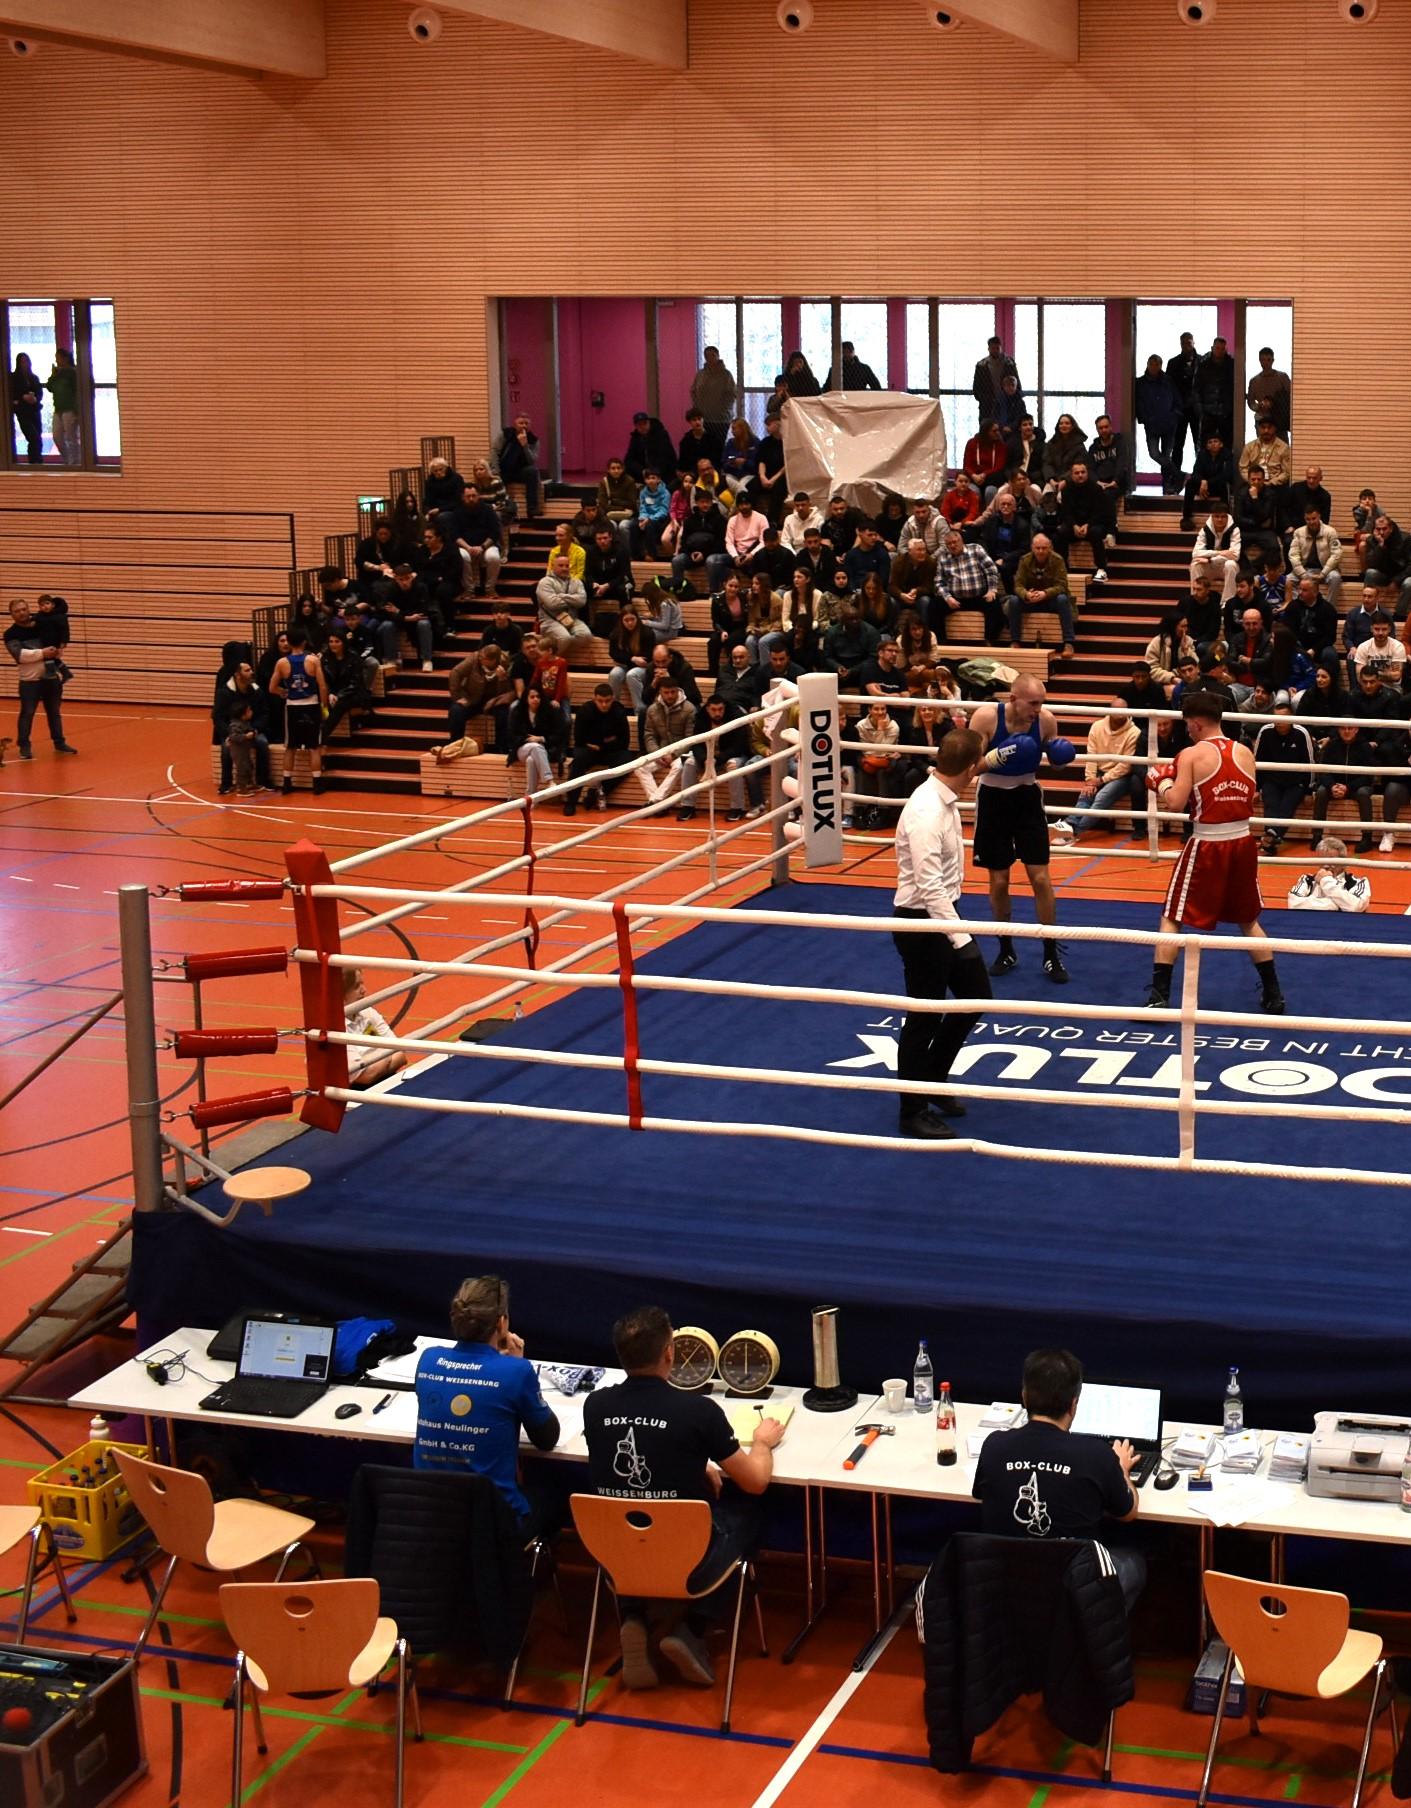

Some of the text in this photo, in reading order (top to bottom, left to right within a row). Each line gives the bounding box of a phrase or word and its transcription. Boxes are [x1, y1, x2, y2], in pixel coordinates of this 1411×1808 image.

[810, 709, 835, 833] DOTLUX
[1211, 780, 1250, 795] BOX-CLUB
[866, 1015, 1084, 1040] QUALT
[1096, 1030, 1271, 1051] BESTER
[1283, 1040, 1329, 1055] IN
[436, 1357, 483, 1371] Ringsprecher
[446, 1376, 500, 1388] WEISSENBURG
[444, 1422, 490, 1434] Neulinger
[603, 1416, 668, 1429] BOX-CLUB
[418, 1437, 438, 1448] GmbH
[1006, 1460, 1071, 1475] BOX-CLUB
[597, 1487, 678, 1499] WEISSENBURG
